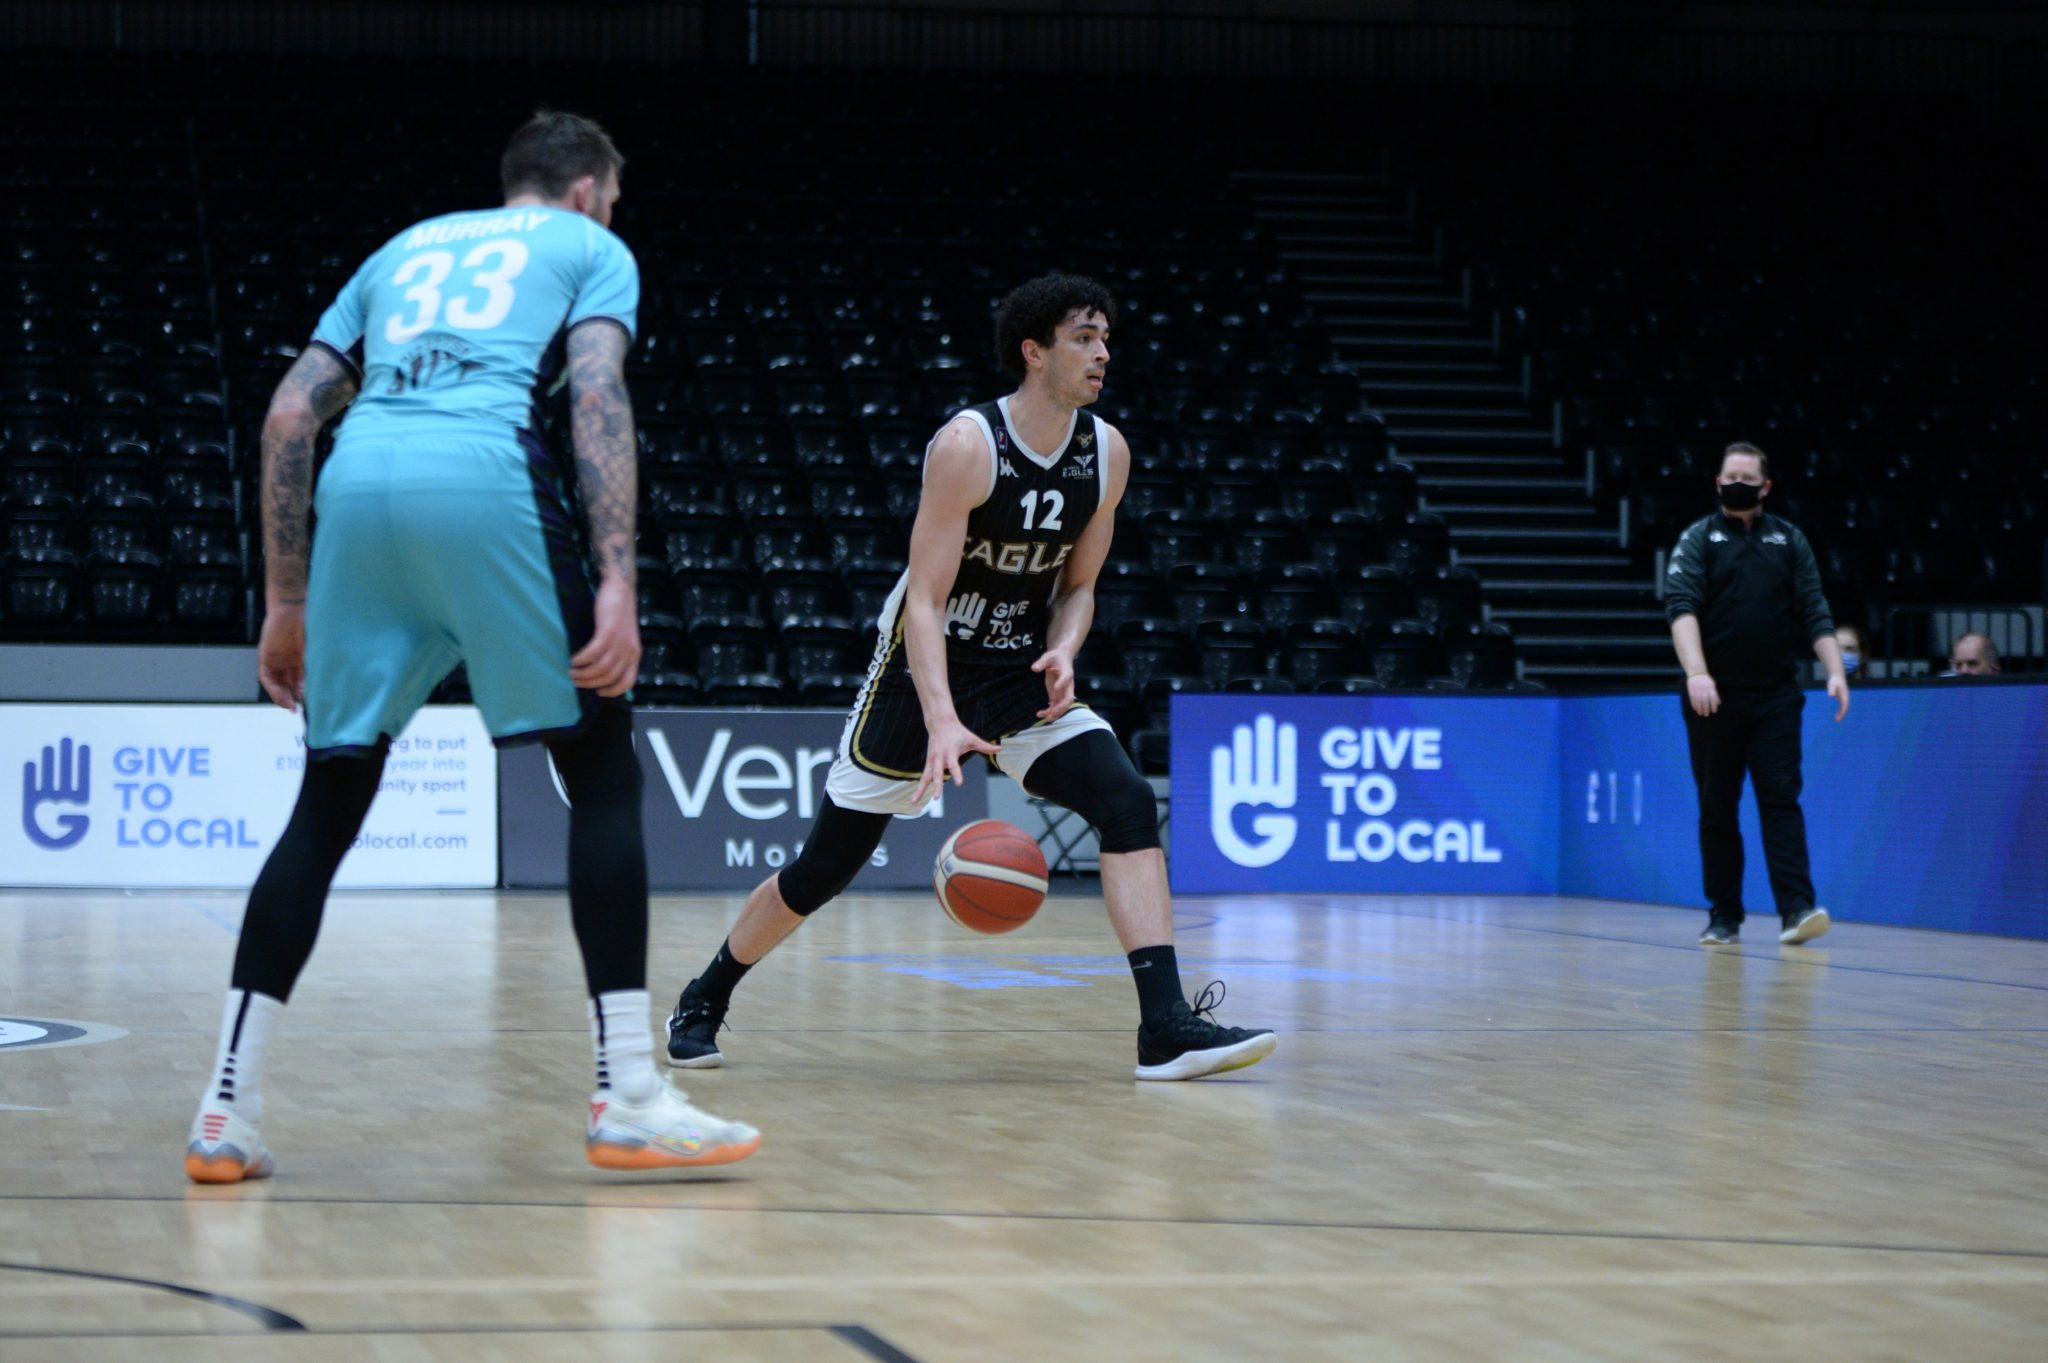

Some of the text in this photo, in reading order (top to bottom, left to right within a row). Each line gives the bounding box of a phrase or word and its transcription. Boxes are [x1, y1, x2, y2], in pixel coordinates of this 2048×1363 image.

[404, 211, 553, 250] MURRAY
[385, 239, 529, 345] 33
[1020, 489, 1065, 531] 12
[965, 537, 1074, 575] AGLE
[992, 600, 1030, 619] GIVE
[989, 619, 1013, 636] TO
[415, 737, 433, 750] to
[437, 737, 467, 753] put
[1319, 726, 1442, 770] GIVE
[112, 746, 211, 777] GIVE
[275, 756, 467, 773] £10 year into
[645, 729, 944, 819] Ver
[113, 782, 173, 812] TO
[421, 780, 467, 796] sport
[1320, 773, 1397, 816] TO
[116, 818, 260, 849] LOCAL
[351, 833, 468, 850] olocal.com
[1326, 820, 1502, 863] LOCAL
